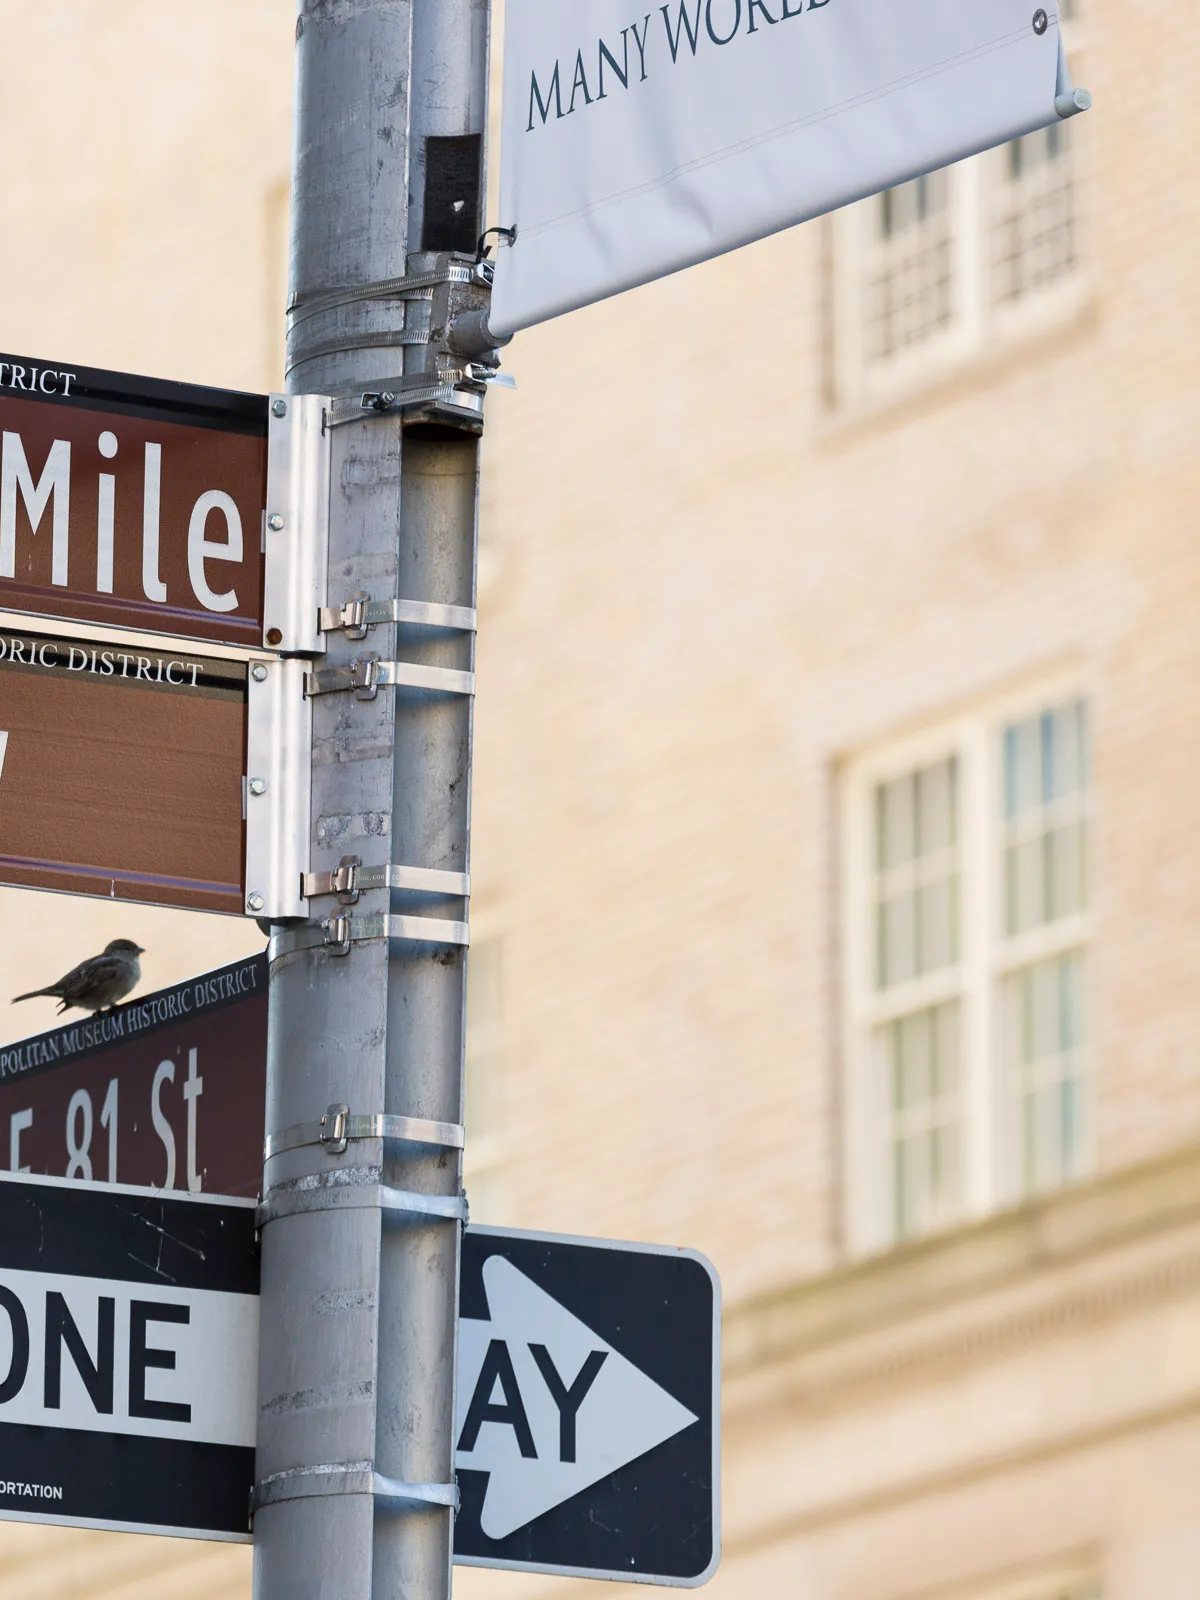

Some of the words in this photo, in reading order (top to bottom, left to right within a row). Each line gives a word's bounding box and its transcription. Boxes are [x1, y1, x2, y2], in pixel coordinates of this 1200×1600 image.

[525, 14, 651, 132] MANY
[0, 430, 244, 612] Mile
[66, 646, 204, 688] DISTRICT
[63, 1014, 125, 1056] MUSEUM
[127, 988, 191, 1033] HISTORIC
[195, 963, 258, 1008] DISTRICT
[65, 1078, 119, 1183] 81
[151, 1047, 204, 1194] St
[456, 1338, 610, 1464] AY
